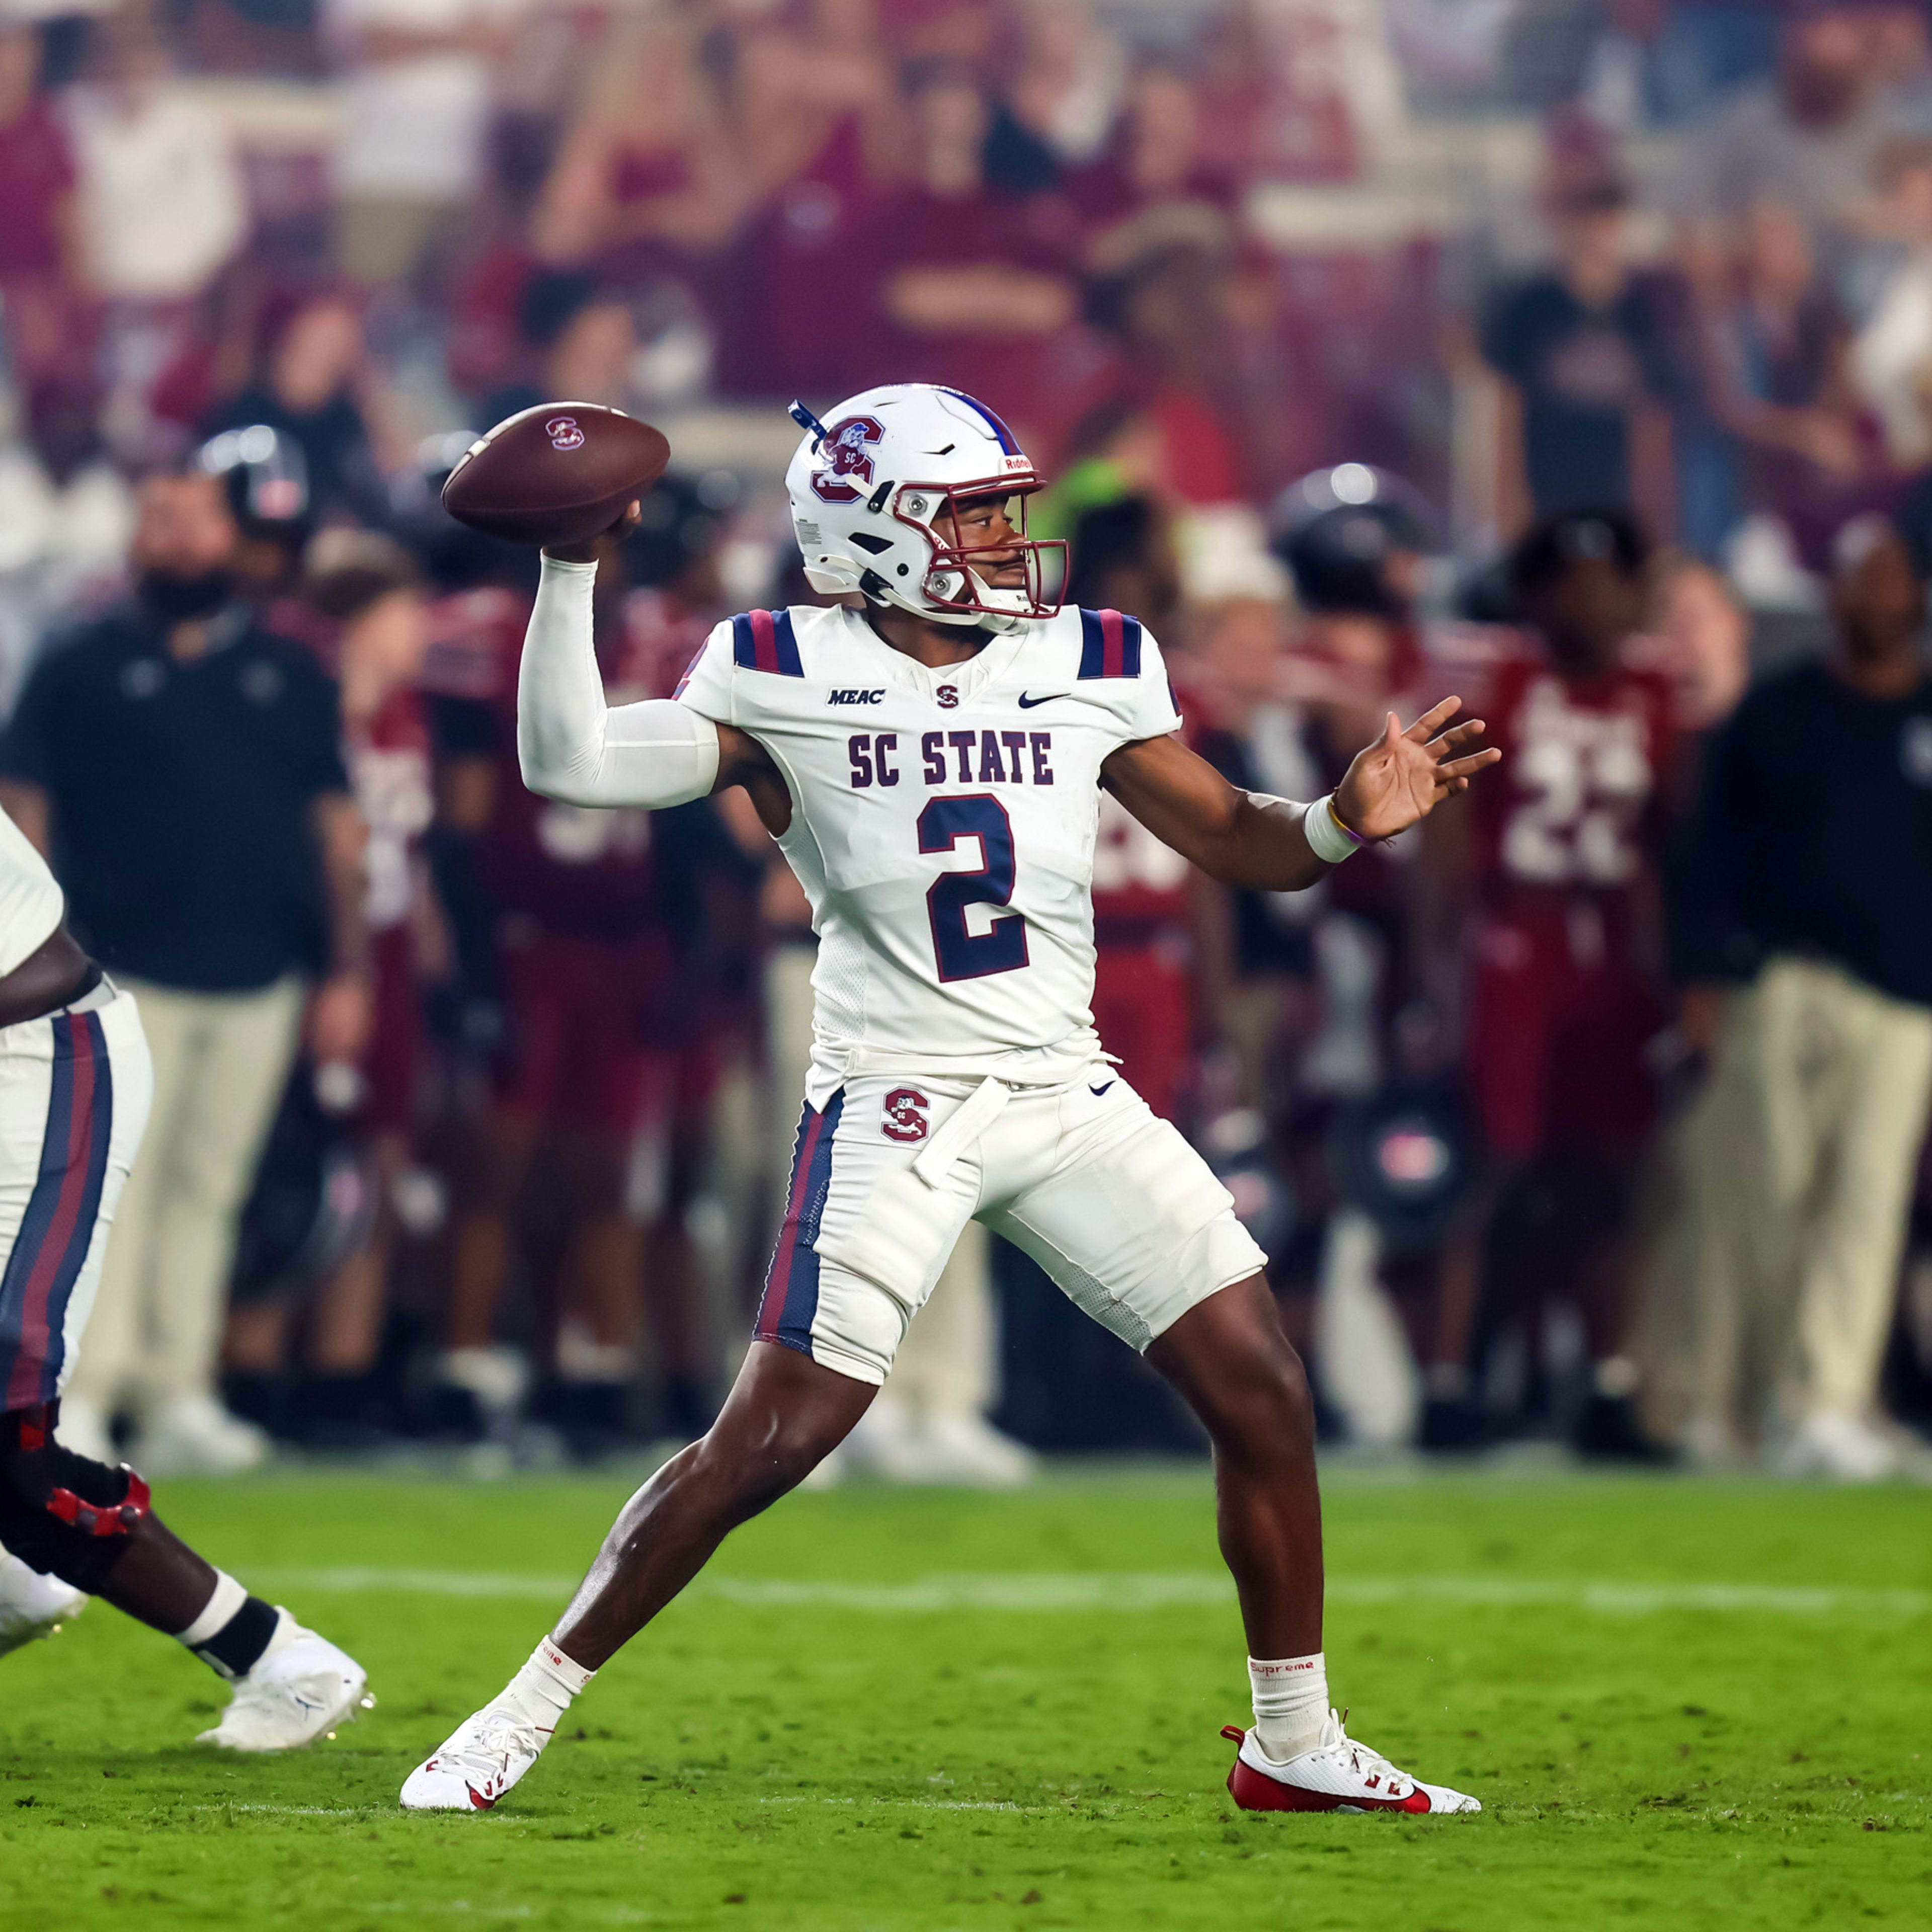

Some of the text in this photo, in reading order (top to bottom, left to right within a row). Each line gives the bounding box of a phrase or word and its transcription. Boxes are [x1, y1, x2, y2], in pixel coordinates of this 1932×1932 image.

[844, 452, 856, 463] SC
[827, 688, 887, 705] MEAC
[848, 730, 1054, 788] SC STATE
[916, 792, 1030, 983] 2
[897, 1111, 906, 1119] SC
[1250, 1661, 1314, 1677] Supreme
